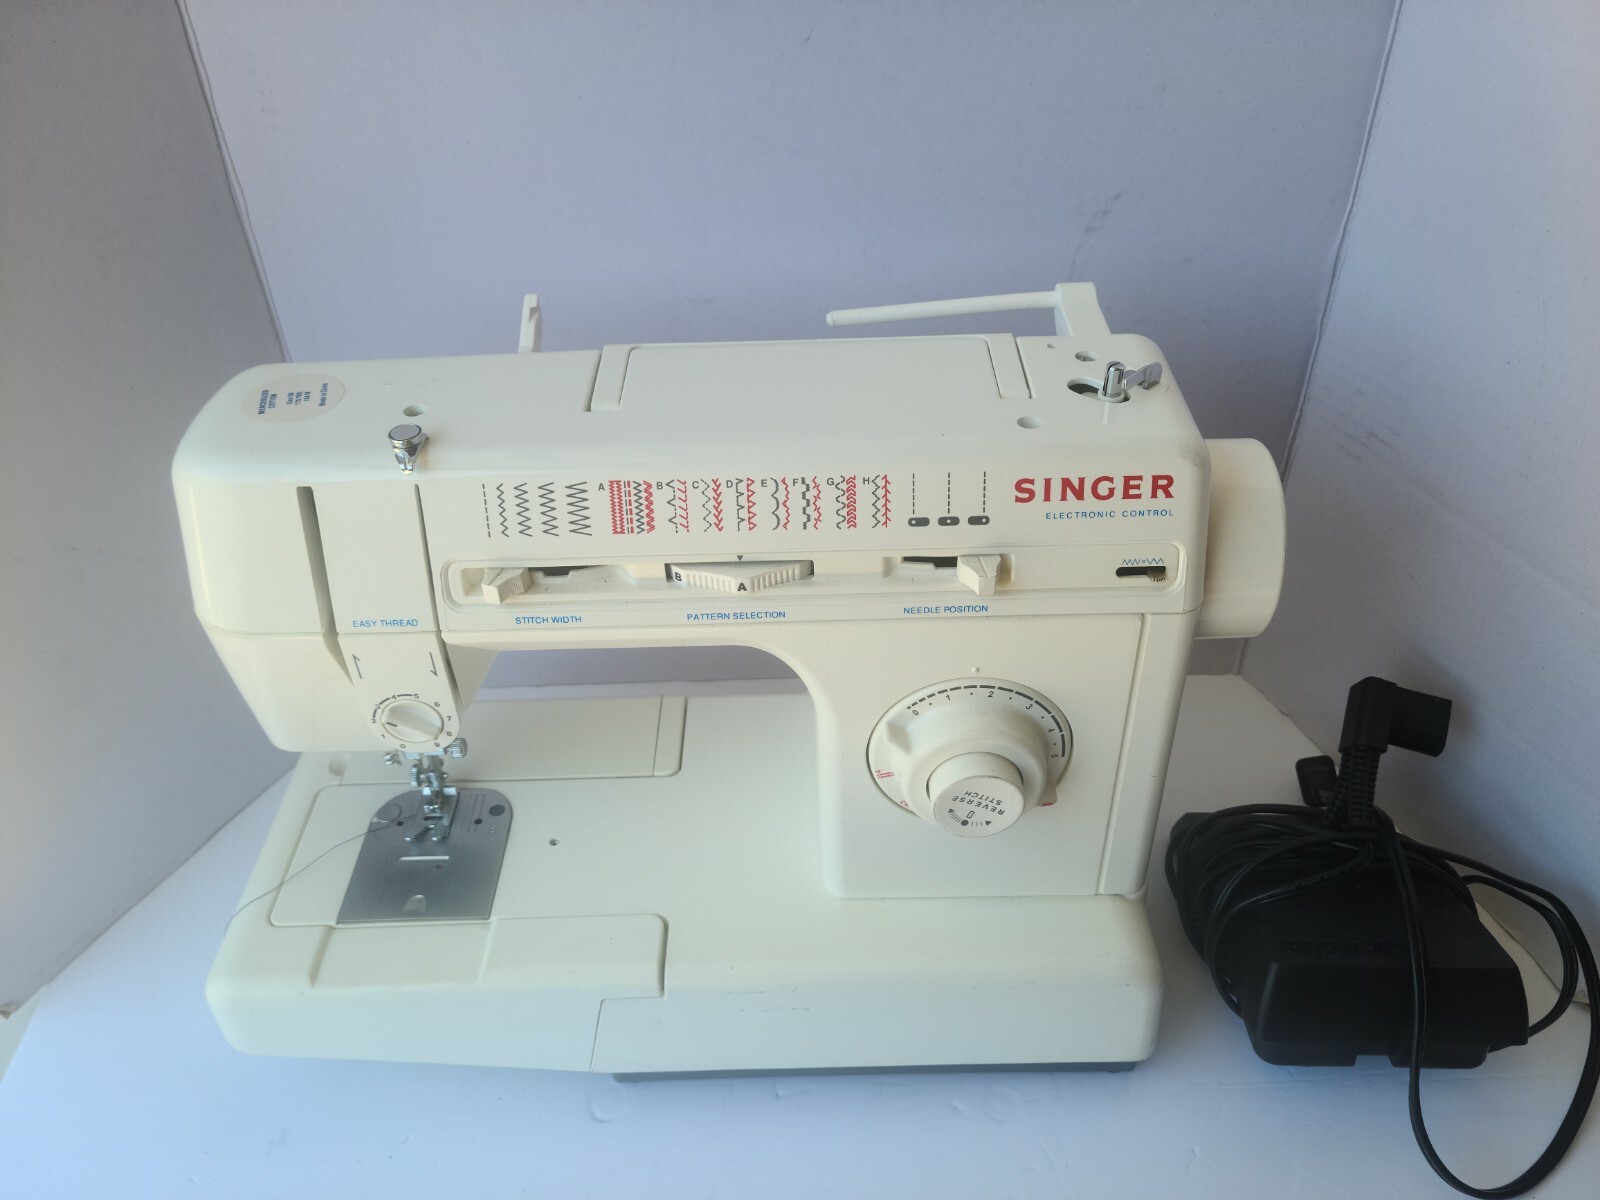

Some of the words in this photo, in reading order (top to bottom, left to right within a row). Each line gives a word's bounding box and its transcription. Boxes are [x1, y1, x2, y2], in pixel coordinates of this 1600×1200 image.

[598, 483, 606, 491] A
[656, 481, 664, 490] B
[691, 480, 700, 489] C
[726, 480, 734, 488] D
[760, 479, 768, 488] E
[792, 478, 799, 487] F
[826, 477, 835, 486] G
[862, 476, 870, 485] H
[1014, 474, 1175, 504] SINGER
[1045, 511, 1116, 520] ELECTRONIC
[1122, 509, 1174, 518] CONTROL
[674, 571, 682, 581] B
[737, 582, 747, 592] A
[687, 612, 730, 621] PATTERN
[732, 611, 786, 620] SELECTION
[903, 606, 941, 614] NEEDLE
[943, 605, 989, 613] POSITION
[352, 620, 377, 628] EASY
[380, 619, 419, 627] THREAD
[515, 616, 549, 625] STITCH
[551, 615, 582, 624] WIDTH
[912, 709, 920, 717] 0
[987, 690, 995, 698] 2
[1025, 703, 1033, 711] 3
[951, 795, 1005, 816] REVERSE
[964, 790, 1003, 806] STITCH
